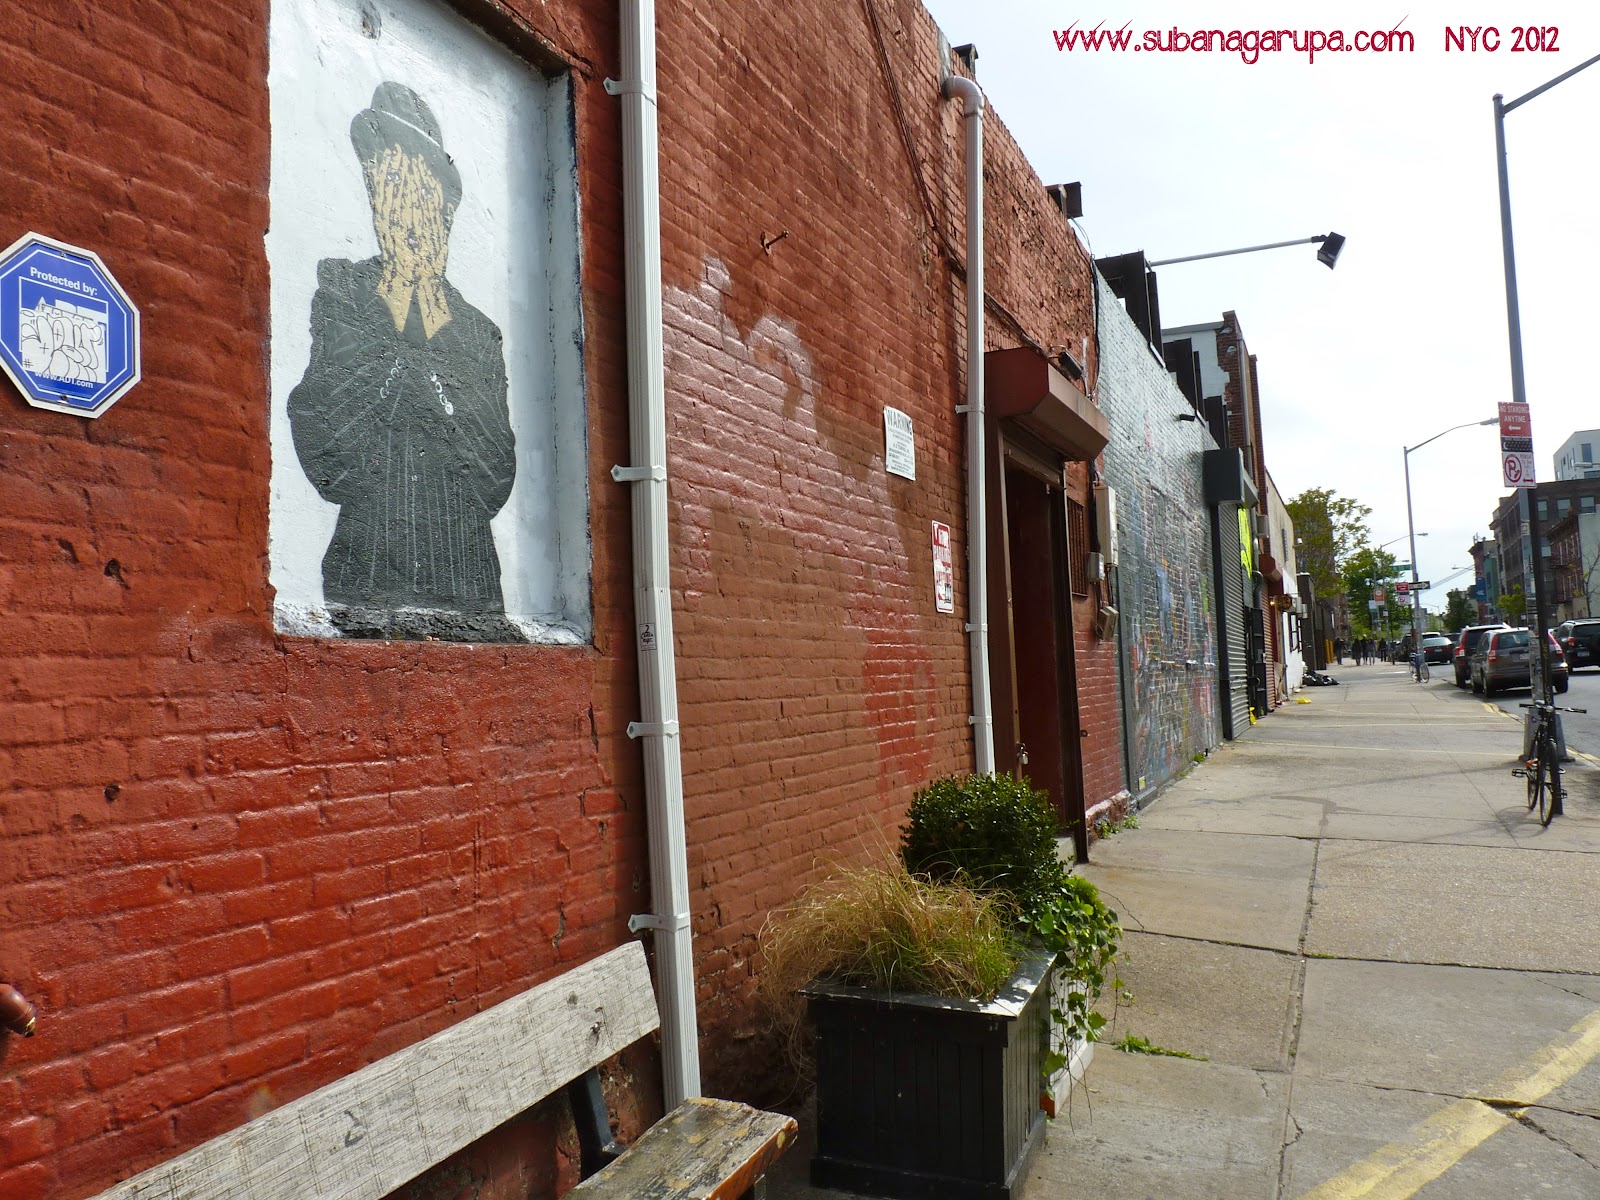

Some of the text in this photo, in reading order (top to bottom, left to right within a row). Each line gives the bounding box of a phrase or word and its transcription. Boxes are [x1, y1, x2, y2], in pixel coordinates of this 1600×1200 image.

[30, 266, 98, 297] Protected by:
[1500, 405, 1507, 413] NO
[1504, 415, 1526, 423] ANYTIME
